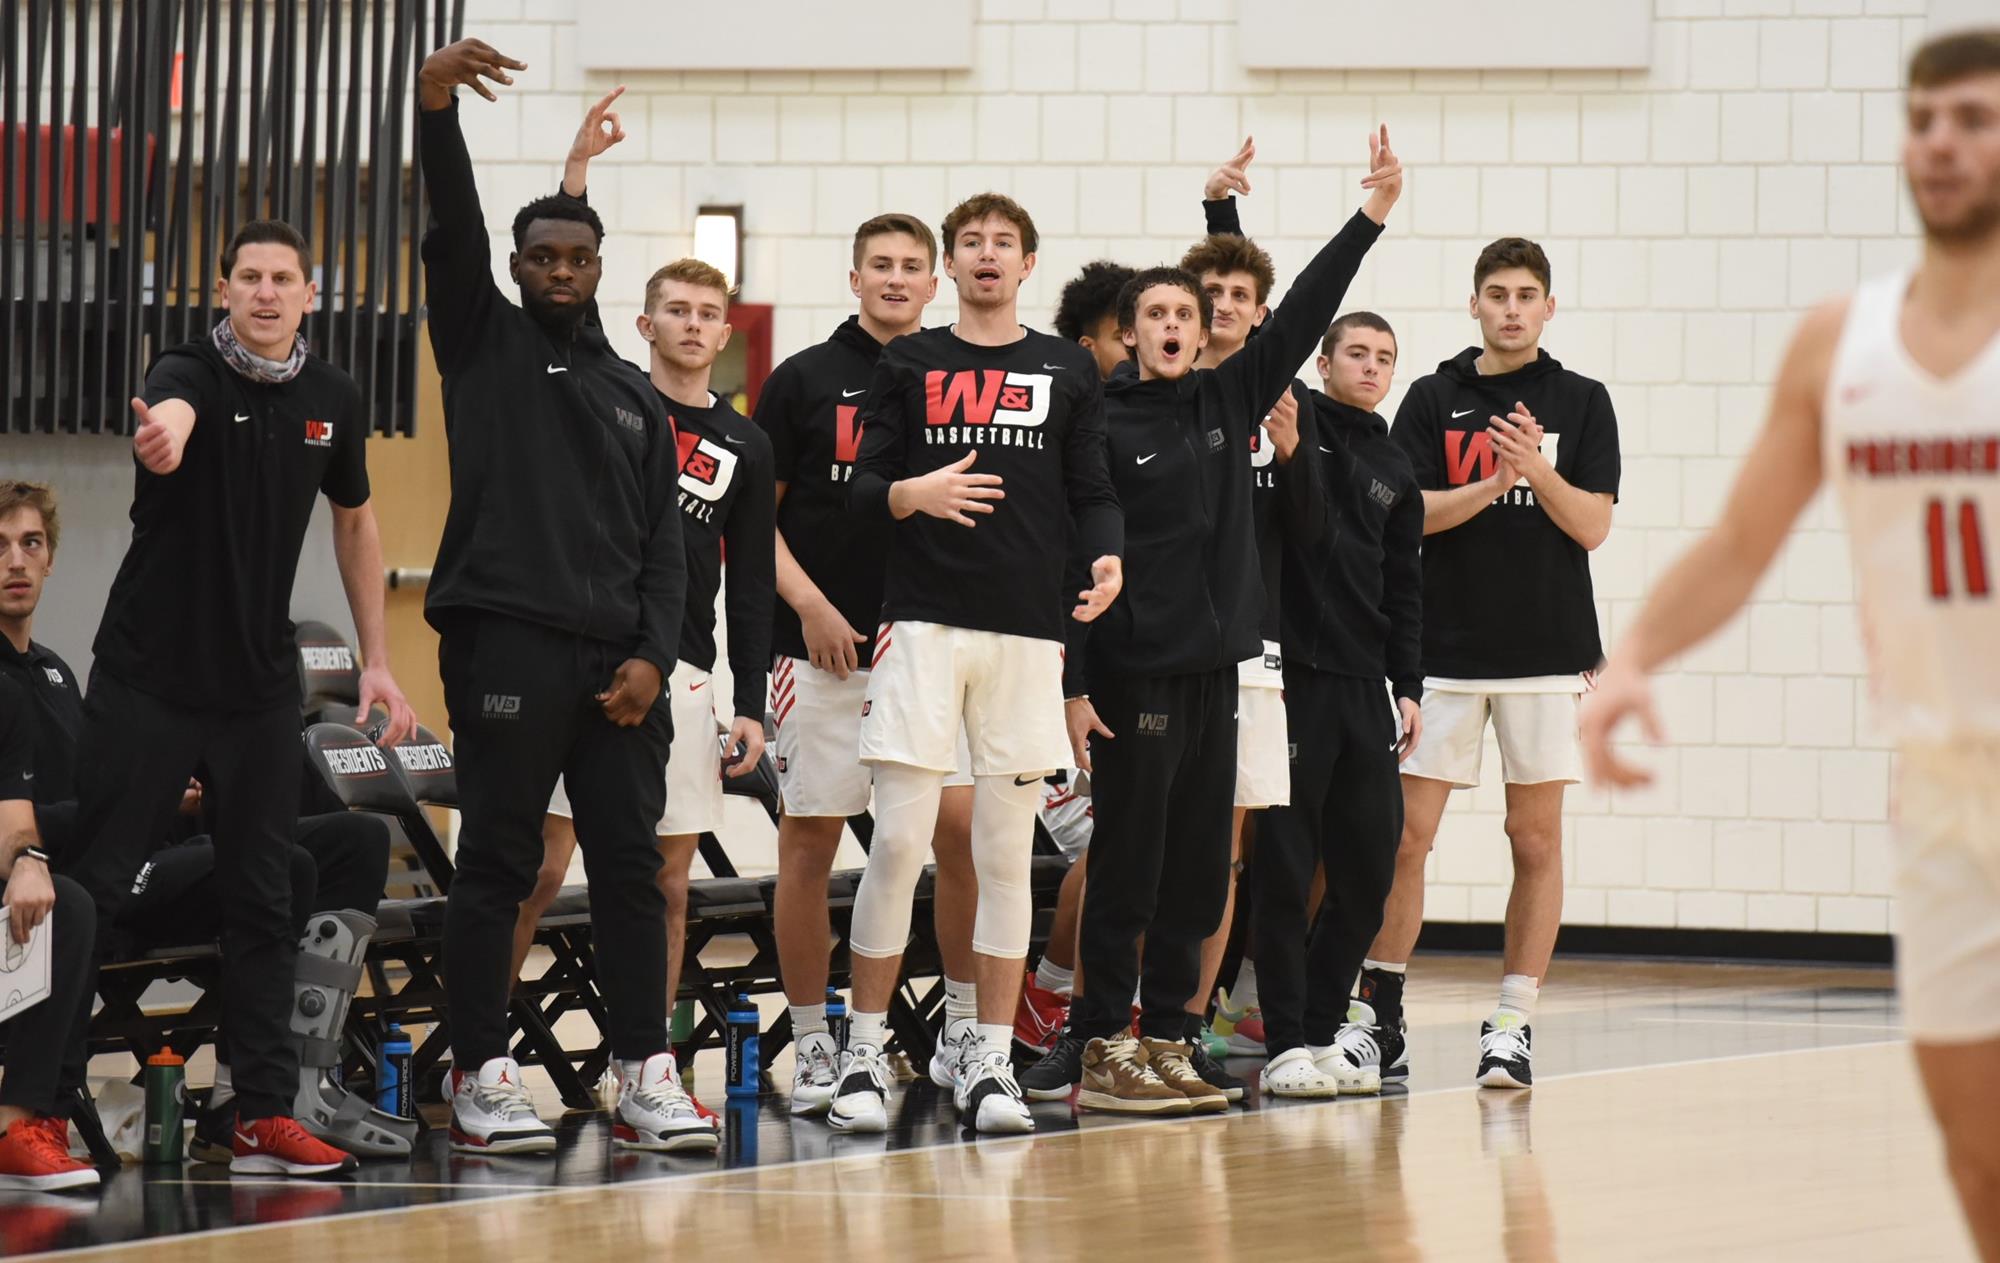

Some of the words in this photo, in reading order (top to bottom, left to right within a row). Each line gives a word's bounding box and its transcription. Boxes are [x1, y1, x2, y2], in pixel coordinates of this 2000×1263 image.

[925, 369, 1054, 427] W&J
[925, 426, 1044, 450] BASKETBALL
[1927, 496, 1990, 600] 11
[301, 647, 353, 671] PRESIDENTS
[322, 746, 386, 775] PRESIDENTS
[394, 744, 451, 771] PRESIDENTS
